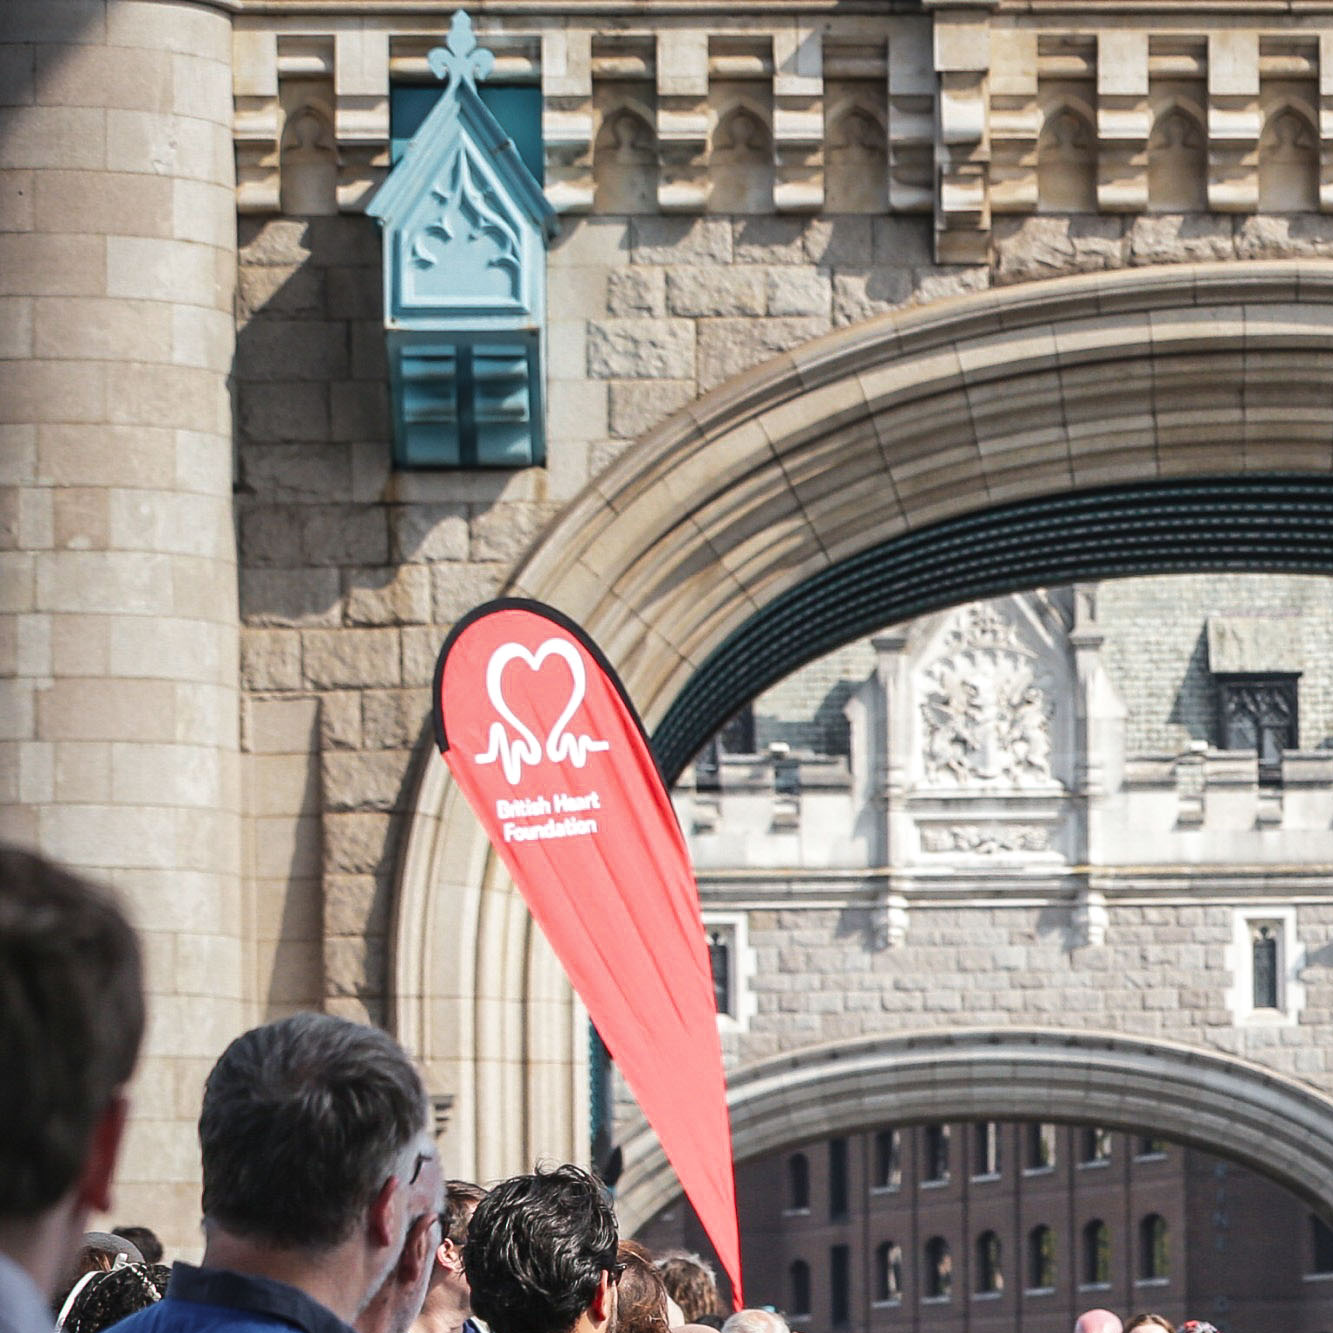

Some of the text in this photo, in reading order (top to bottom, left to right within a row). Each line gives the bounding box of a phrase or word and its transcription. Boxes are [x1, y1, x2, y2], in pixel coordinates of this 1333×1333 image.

[496, 791, 601, 820] British Heart
[503, 816, 597, 843] Foundation
